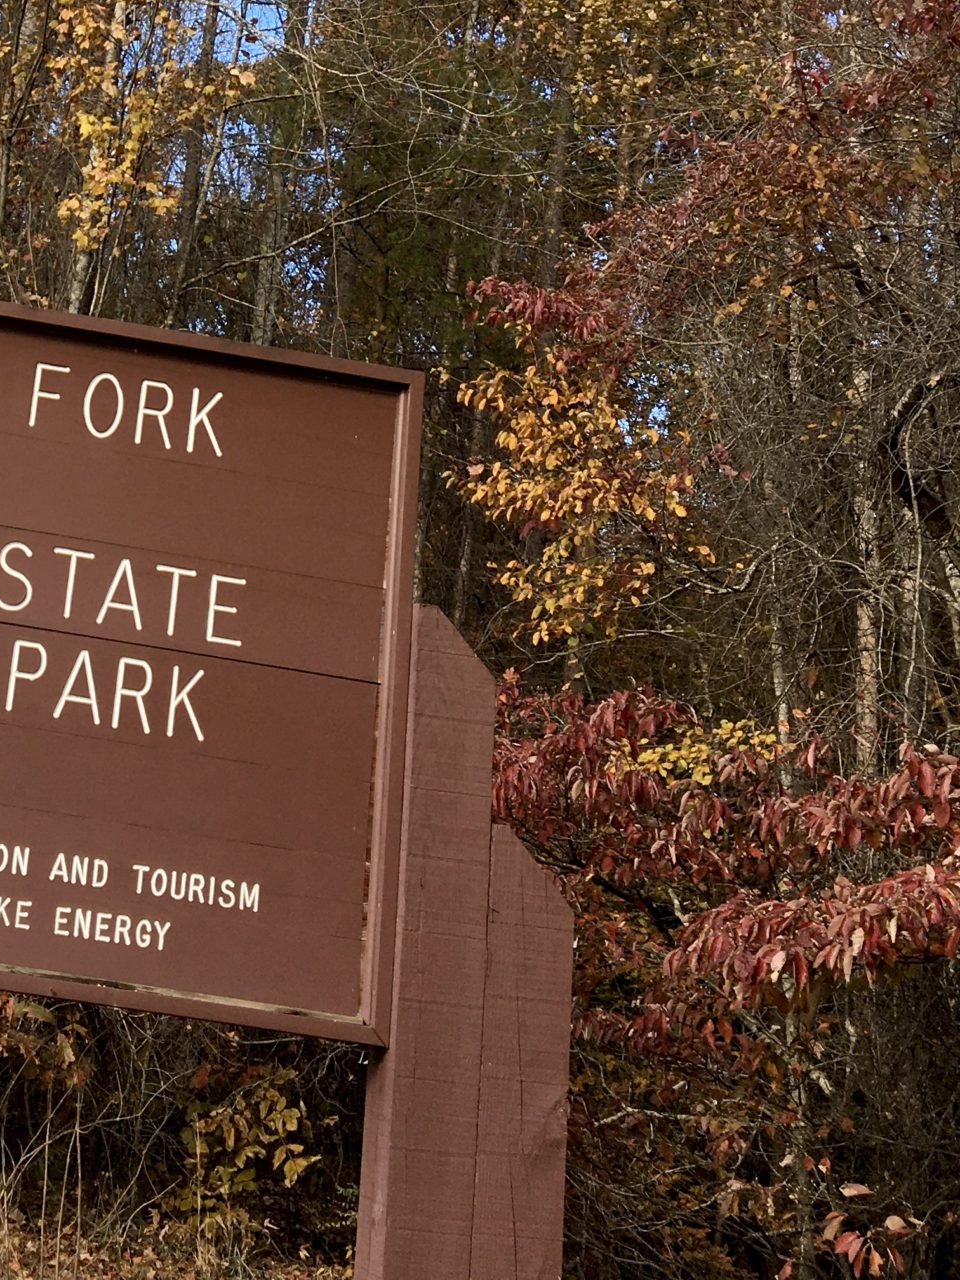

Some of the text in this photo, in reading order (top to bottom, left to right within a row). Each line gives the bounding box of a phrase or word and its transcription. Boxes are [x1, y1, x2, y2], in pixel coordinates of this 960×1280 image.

[28, 362, 223, 458] FORK
[5, 639, 204, 742] PARK
[48, 852, 109, 888] AND
[132, 864, 261, 913] TOURISM
[53, 906, 172, 951] ENERGY
